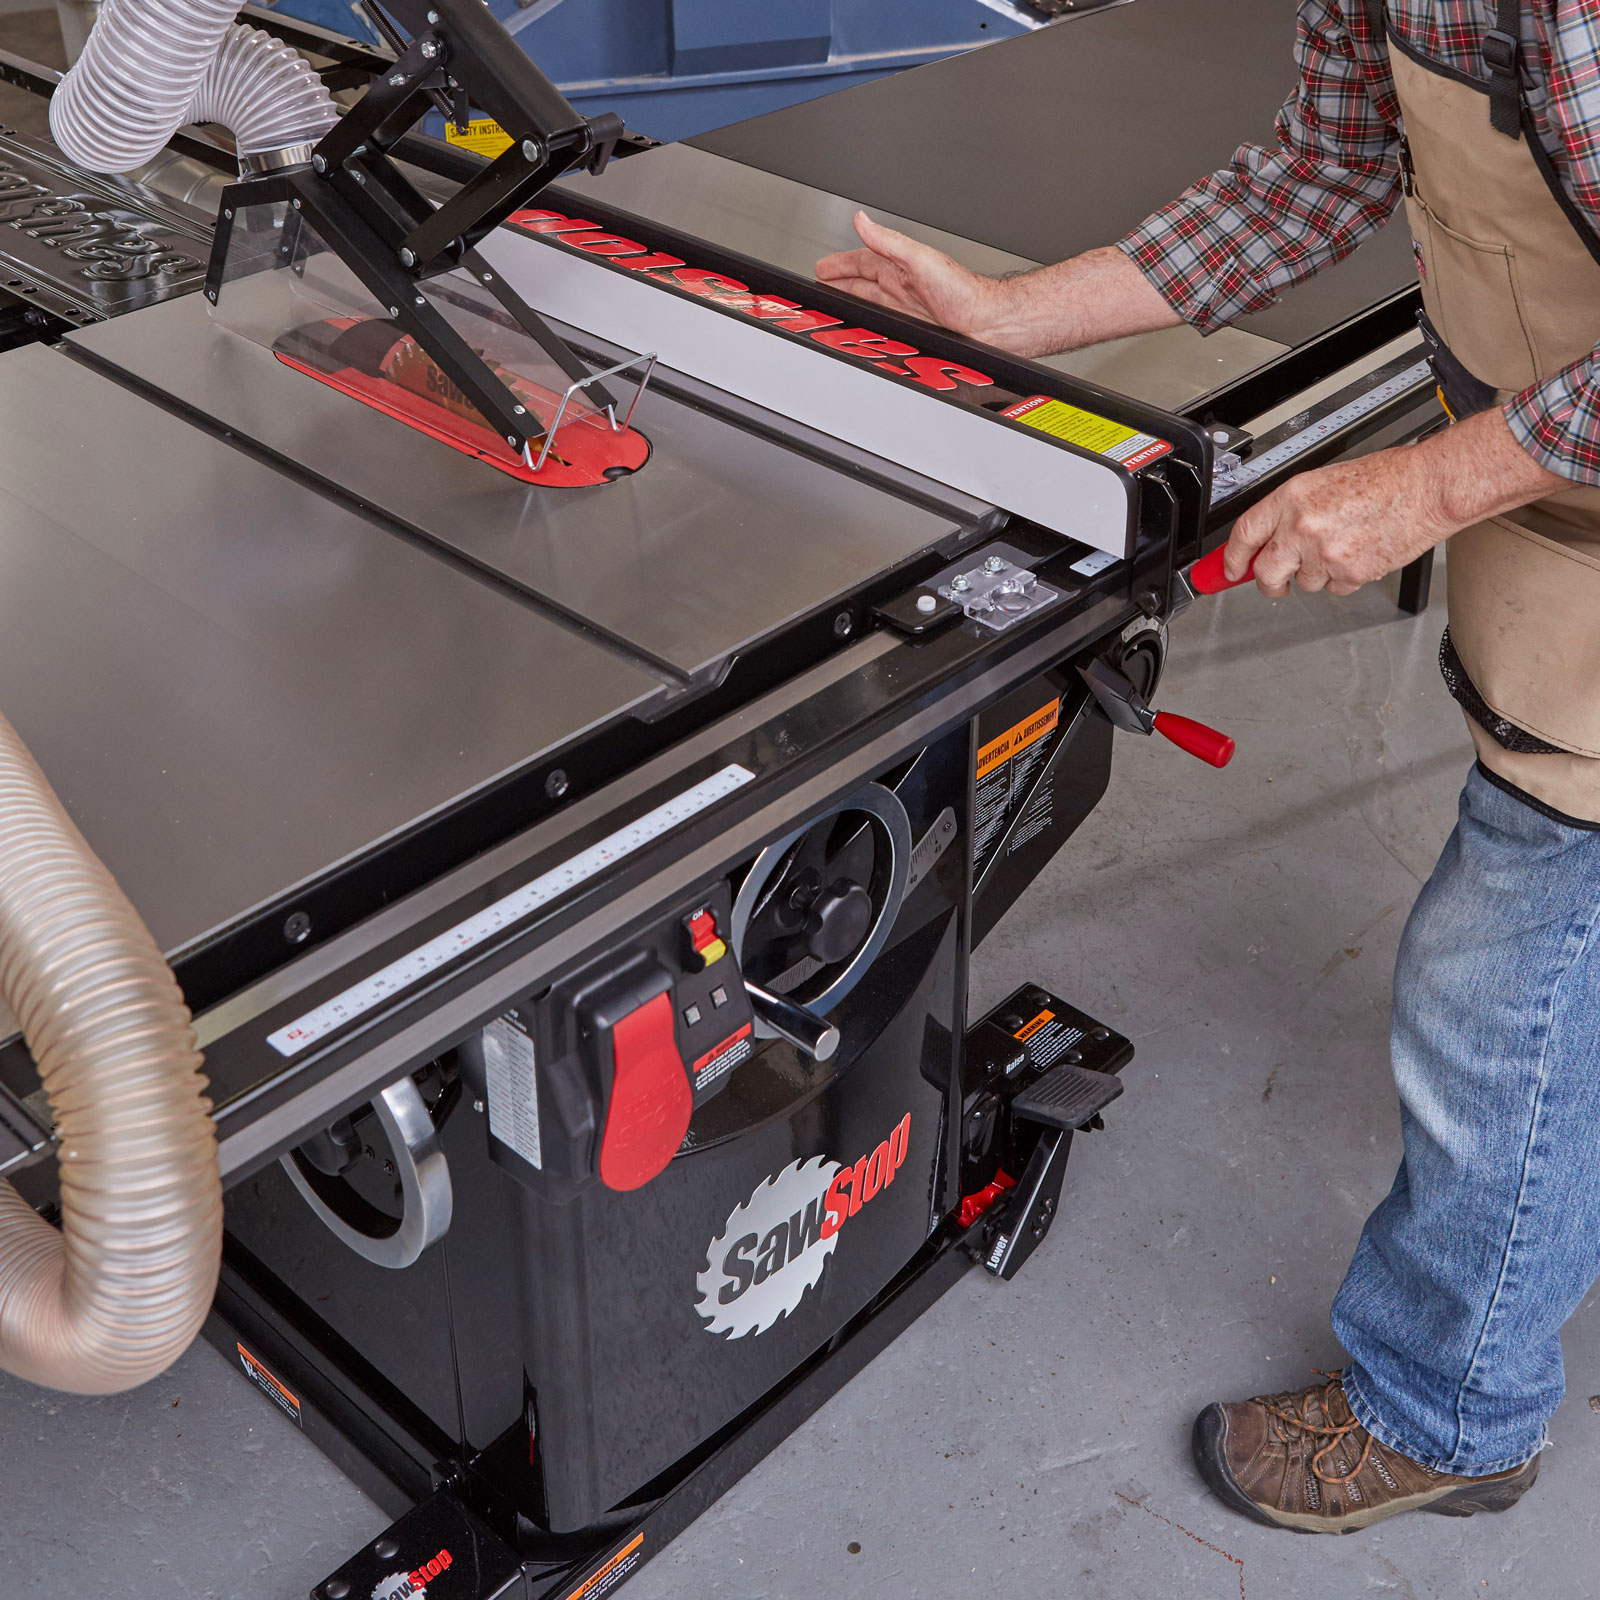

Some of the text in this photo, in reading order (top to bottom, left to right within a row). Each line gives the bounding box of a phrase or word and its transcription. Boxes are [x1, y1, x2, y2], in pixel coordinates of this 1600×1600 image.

[505, 209, 995, 391] SawStop
[1004, 397, 1045, 418] TENTION
[1123, 444, 1166, 468] TTENTION
[1023, 707, 1058, 739] AVERTISSEMENT
[692, 909, 704, 921] ON
[1018, 1018, 1045, 1040] WARNING
[1005, 1053, 1025, 1075] Raise
[718, 1111, 911, 1306] SawStop
[986, 1235, 1009, 1269] Lower
[379, 1548, 453, 1600] awStop
[590, 1557, 618, 1584] WARNING
